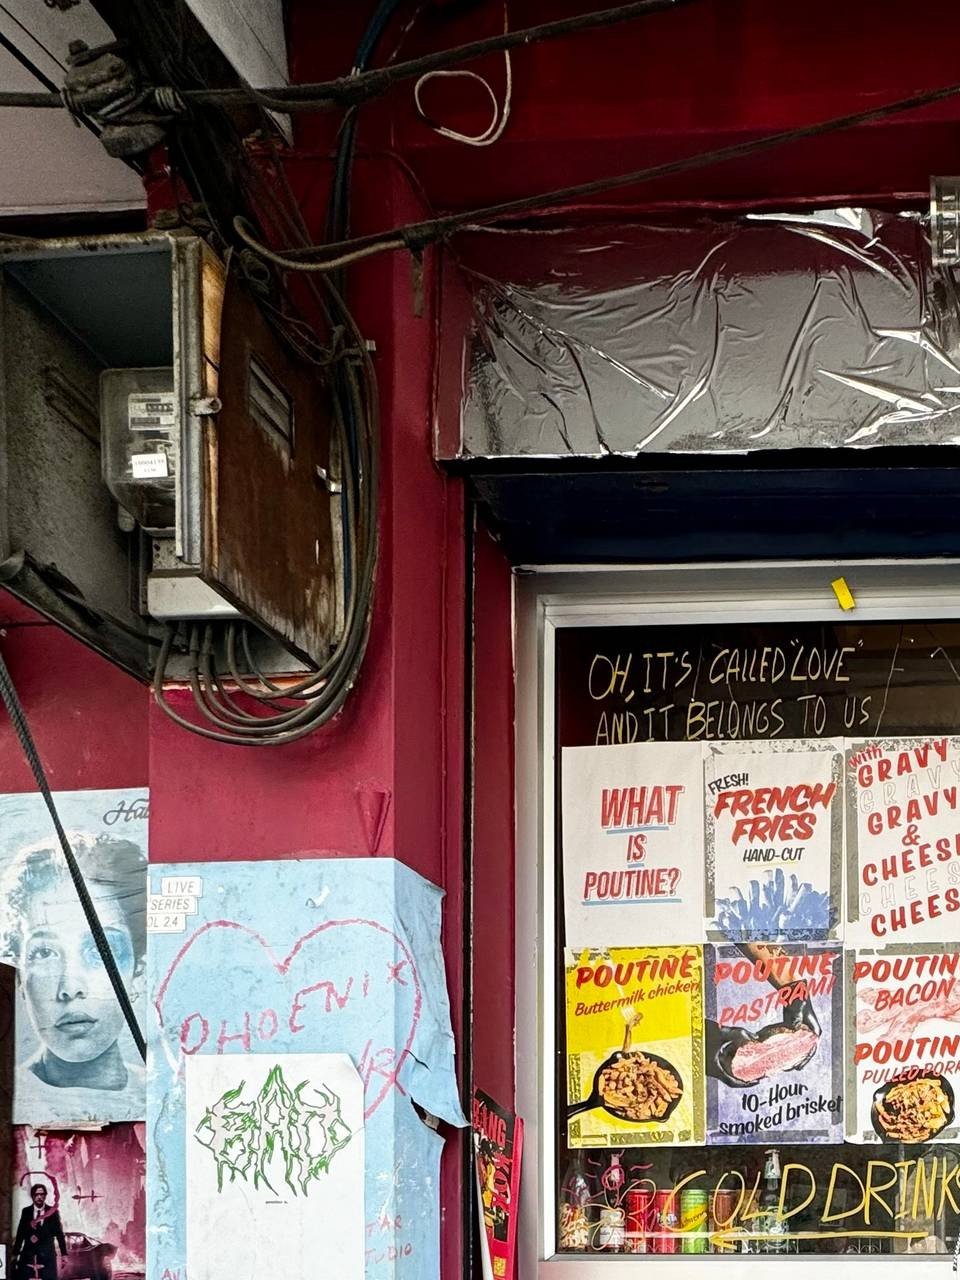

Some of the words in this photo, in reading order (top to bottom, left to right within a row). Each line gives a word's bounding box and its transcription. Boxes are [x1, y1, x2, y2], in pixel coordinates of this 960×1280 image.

[589, 653, 634, 702] OH,
[643, 650, 692, 693] IT'S
[709, 645, 785, 686] CALLED
[596, 710, 638, 745] AND
[645, 705, 674, 742] IT
[686, 699, 785, 740] BELONGS
[797, 694, 826, 735] TO
[844, 695, 872, 726] US
[848, 745, 884, 769] with
[857, 738, 950, 788] GRAVY
[707, 772, 749, 795] FRESH!
[713, 781, 837, 819] FRENCH
[600, 785, 684, 829] WHAT
[867, 786, 958, 835] GRAVY
[731, 814, 817, 847] FRIES
[901, 824, 921, 846] &
[626, 833, 648, 862] IS
[742, 847, 805, 863] HAND-CUT
[167, 881, 195, 893] LIVE
[582, 867, 682, 900] POUTINE?
[150, 898, 190, 911] SERIES
[163, 916, 179, 928] 2.4
[576, 953, 698, 990] POUTINE
[713, 950, 838, 987] POUTINE
[574, 989, 646, 1018] Buttermilk
[646, 979, 700, 1005] chicken
[717, 974, 837, 1027] PASTRAMI
[873, 979, 956, 1012] BACON
[861, 1066, 928, 1085] PULLED
[741, 1081, 810, 1113] 10-Hour
[719, 1112, 783, 1137] smoked
[785, 1093, 843, 1127] brisket
[662, 1163, 816, 1232] COLD
